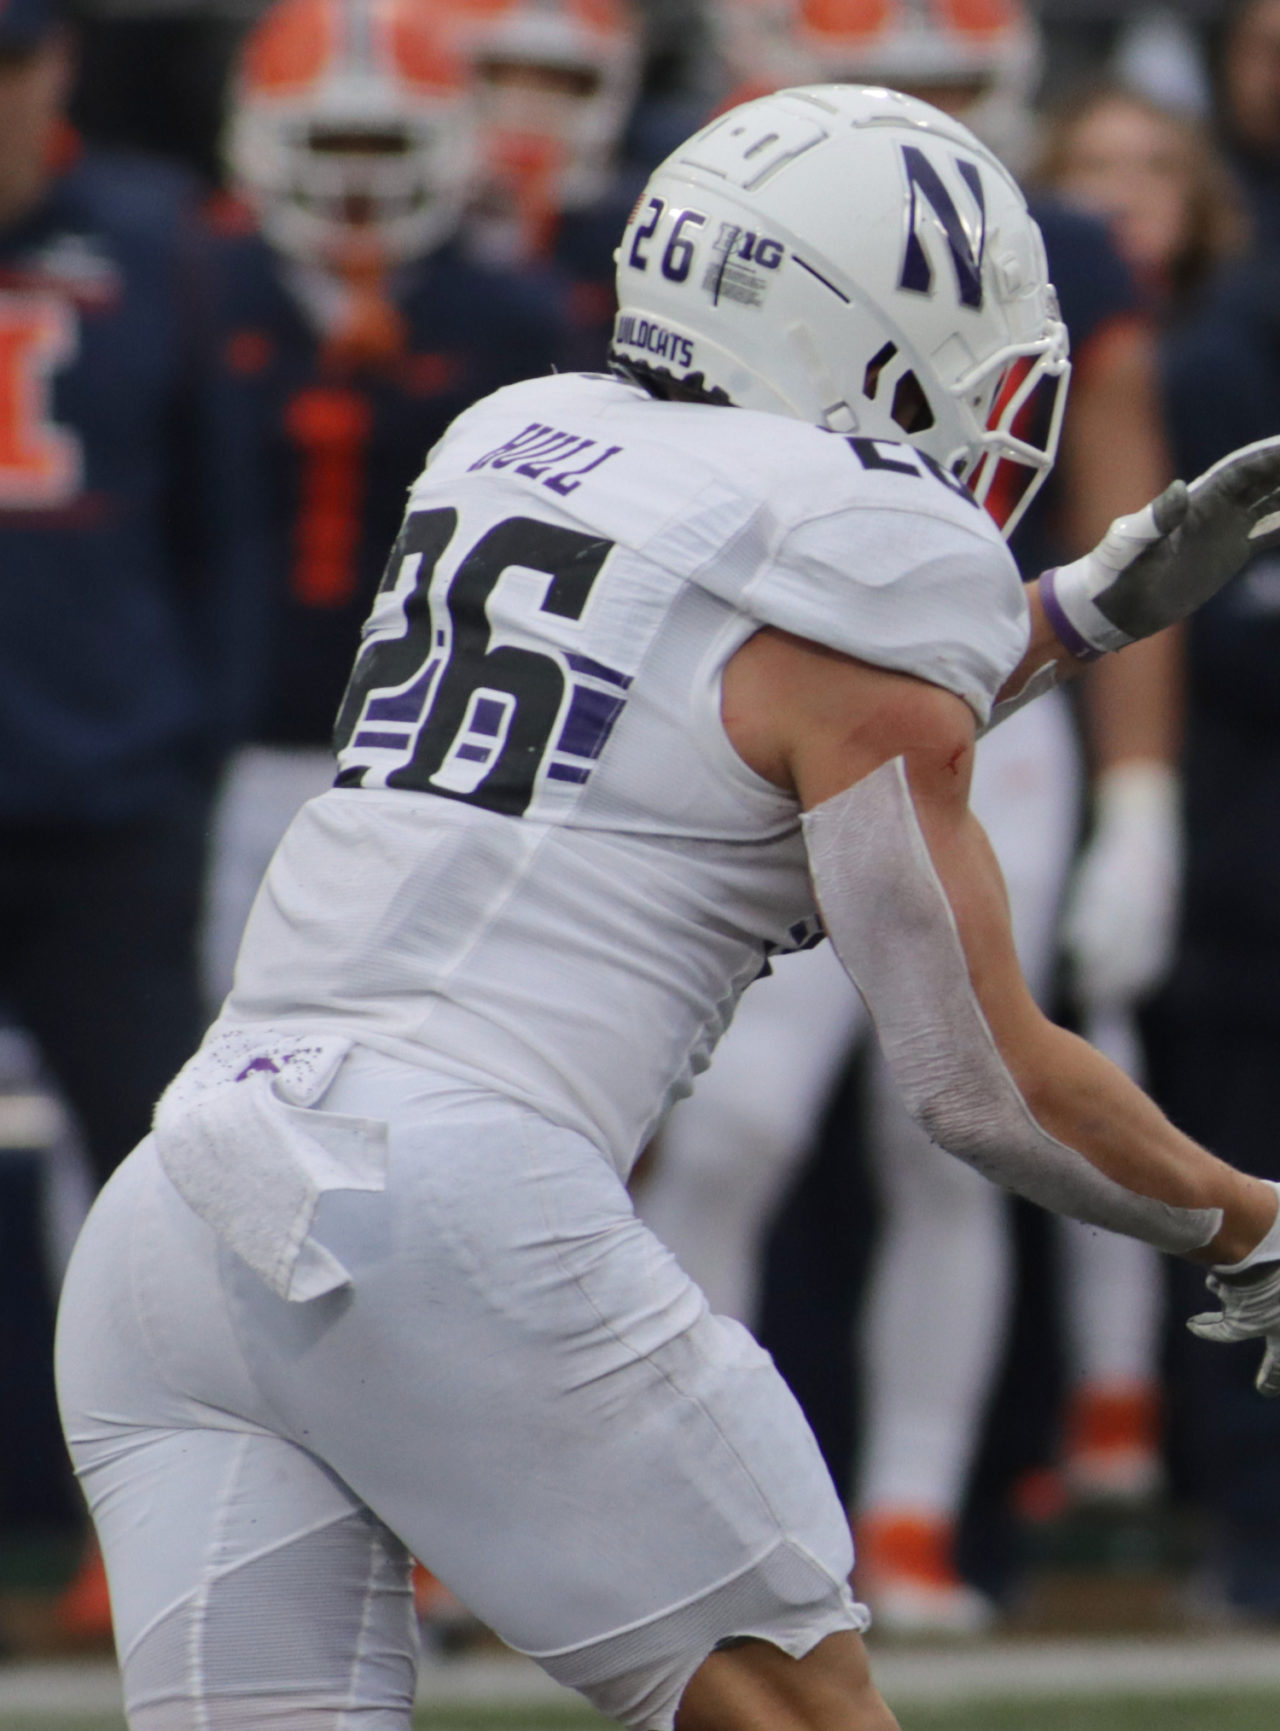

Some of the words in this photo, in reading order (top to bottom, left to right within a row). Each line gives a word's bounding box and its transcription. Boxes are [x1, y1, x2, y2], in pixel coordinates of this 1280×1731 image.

[629, 198, 705, 283] 26
[896, 143, 986, 313] N
[466, 422, 624, 496] HULL
[332, 506, 616, 818] 26
